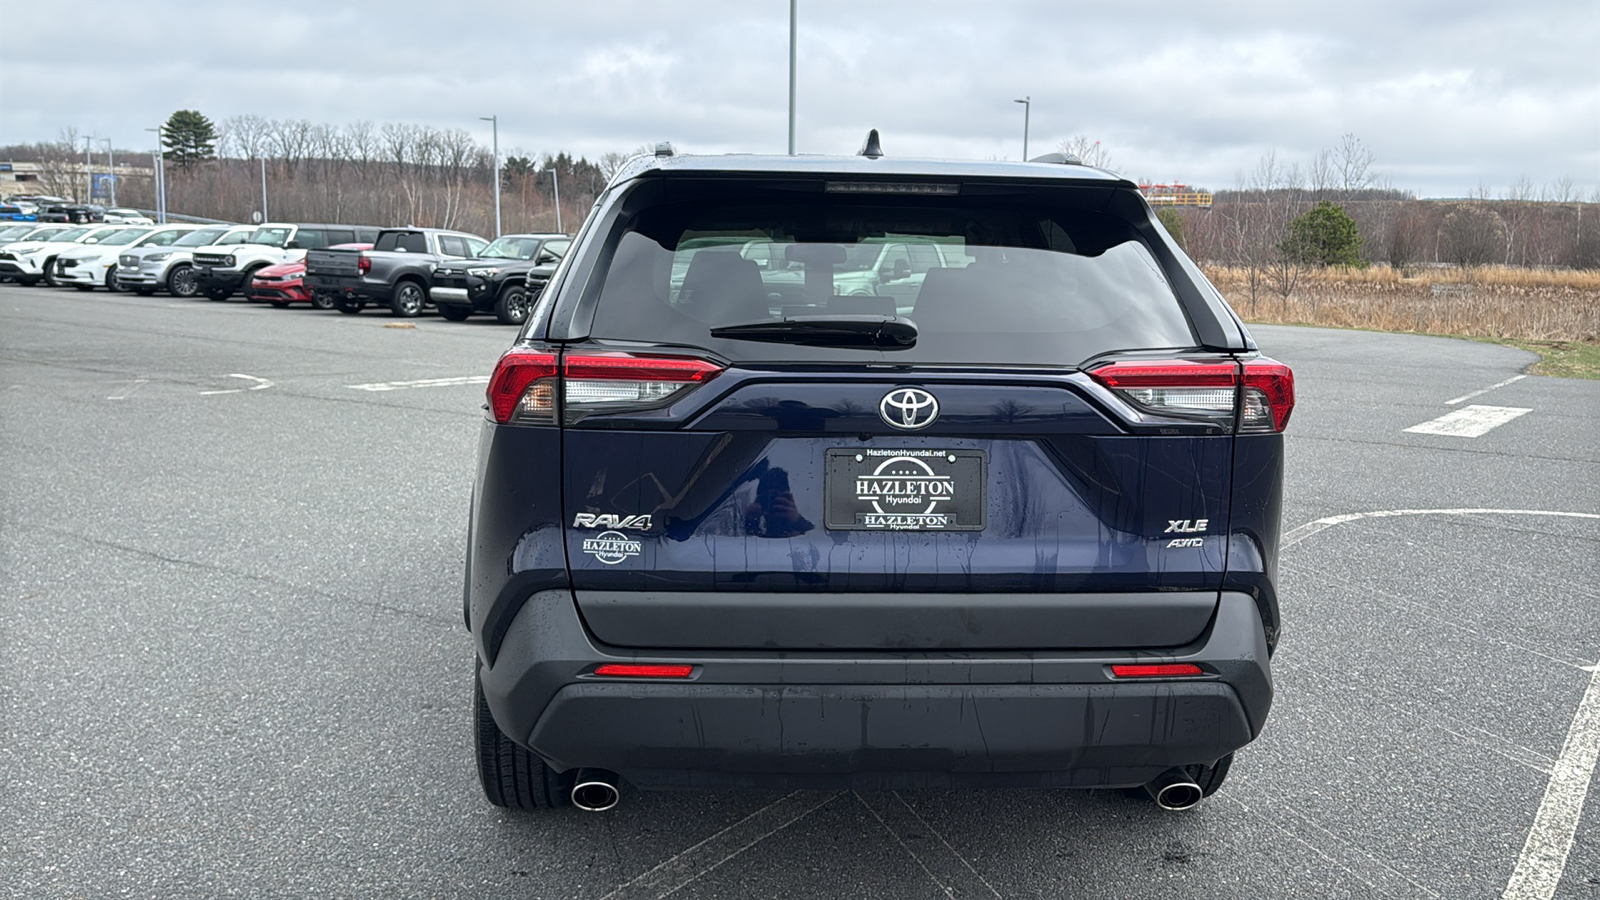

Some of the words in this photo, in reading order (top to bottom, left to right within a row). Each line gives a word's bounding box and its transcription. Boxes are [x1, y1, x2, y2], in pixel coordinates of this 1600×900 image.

[866, 449, 946, 457] HazletonHyundai.net
[856, 480, 955, 495] HAZLETON
[886, 495, 922, 506] Hyundai
[573, 513, 652, 530] RAV4
[864, 516, 948, 525] HAZLETON
[1164, 519, 1209, 533] XLE
[583, 541, 641, 552] HAZLETON
[1166, 538, 1204, 548] AWD
[599, 550, 624, 558] Hyundai
